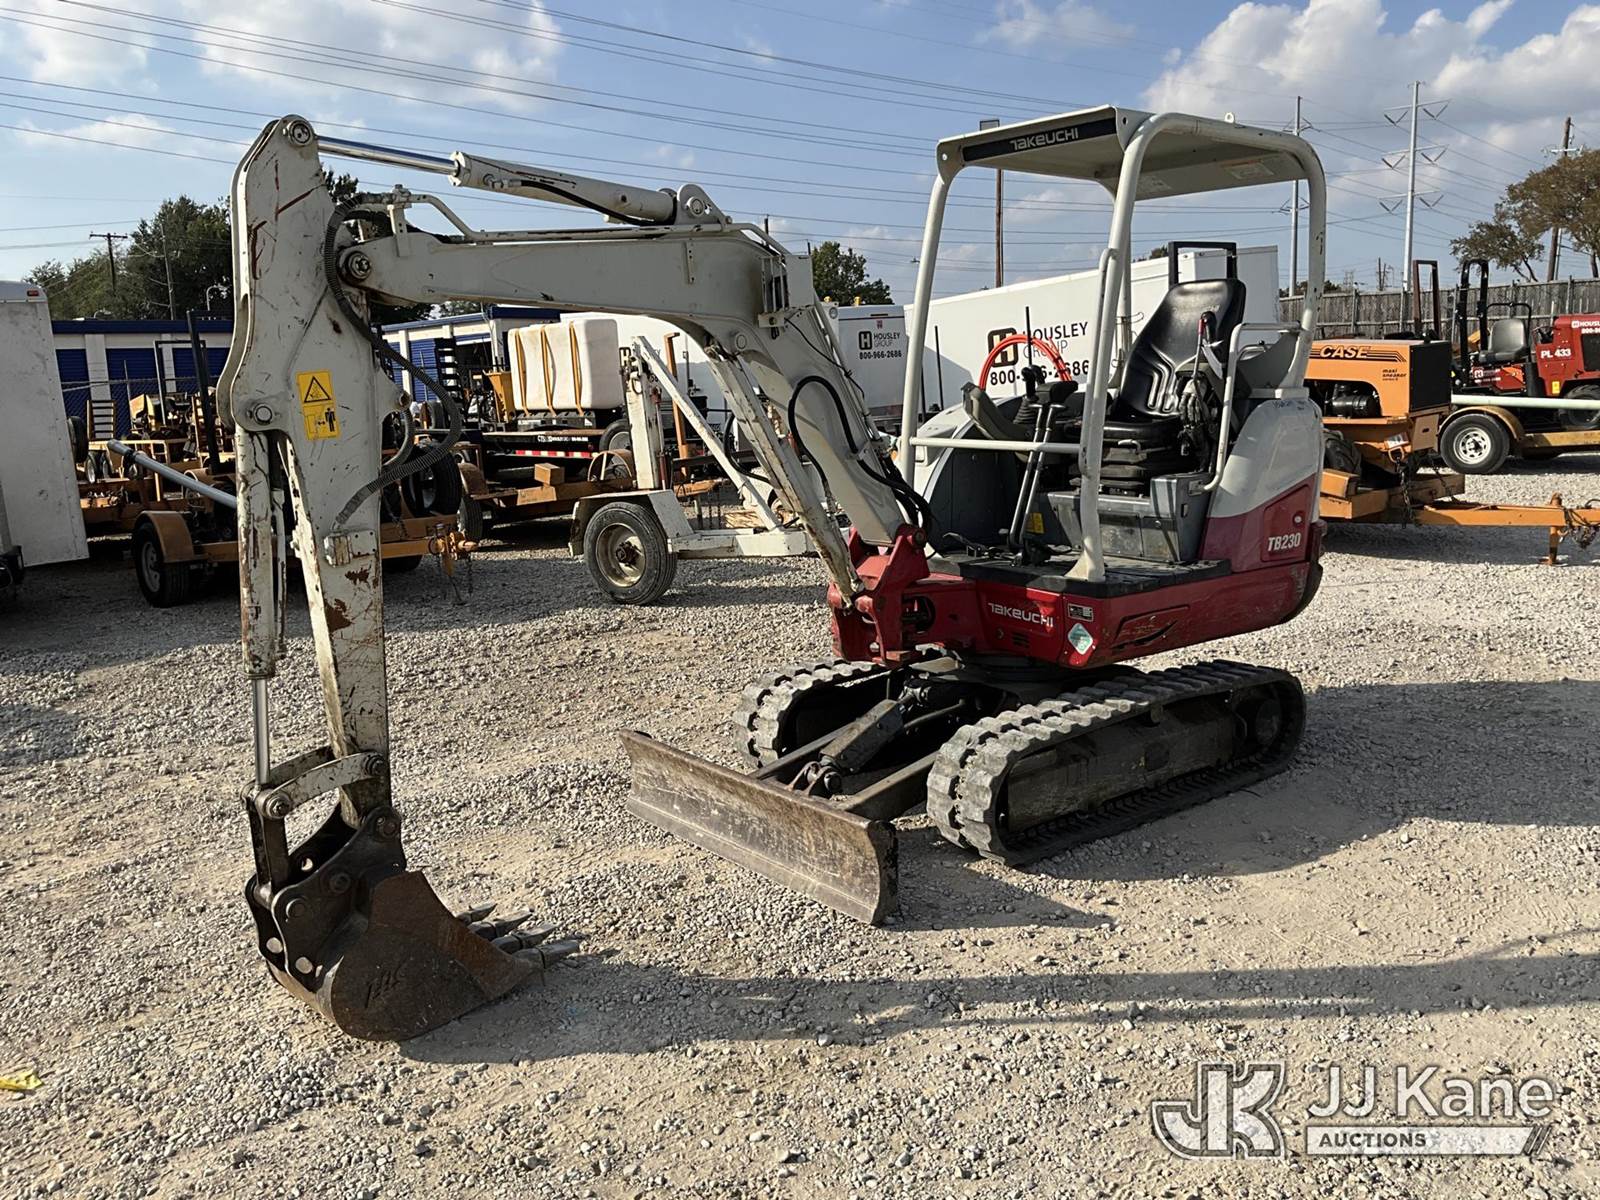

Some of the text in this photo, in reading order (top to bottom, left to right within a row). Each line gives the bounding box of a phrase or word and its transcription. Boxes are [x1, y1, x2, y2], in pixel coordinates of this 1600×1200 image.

[873, 332, 901, 340] HOUSLEY
[1022, 320, 1089, 345] OUSLEY
[859, 350, 902, 360] 800-966-2686
[1320, 345, 1371, 359] CASE
[1541, 348, 1572, 359] PL 433
[1268, 532, 1302, 551] TB230
